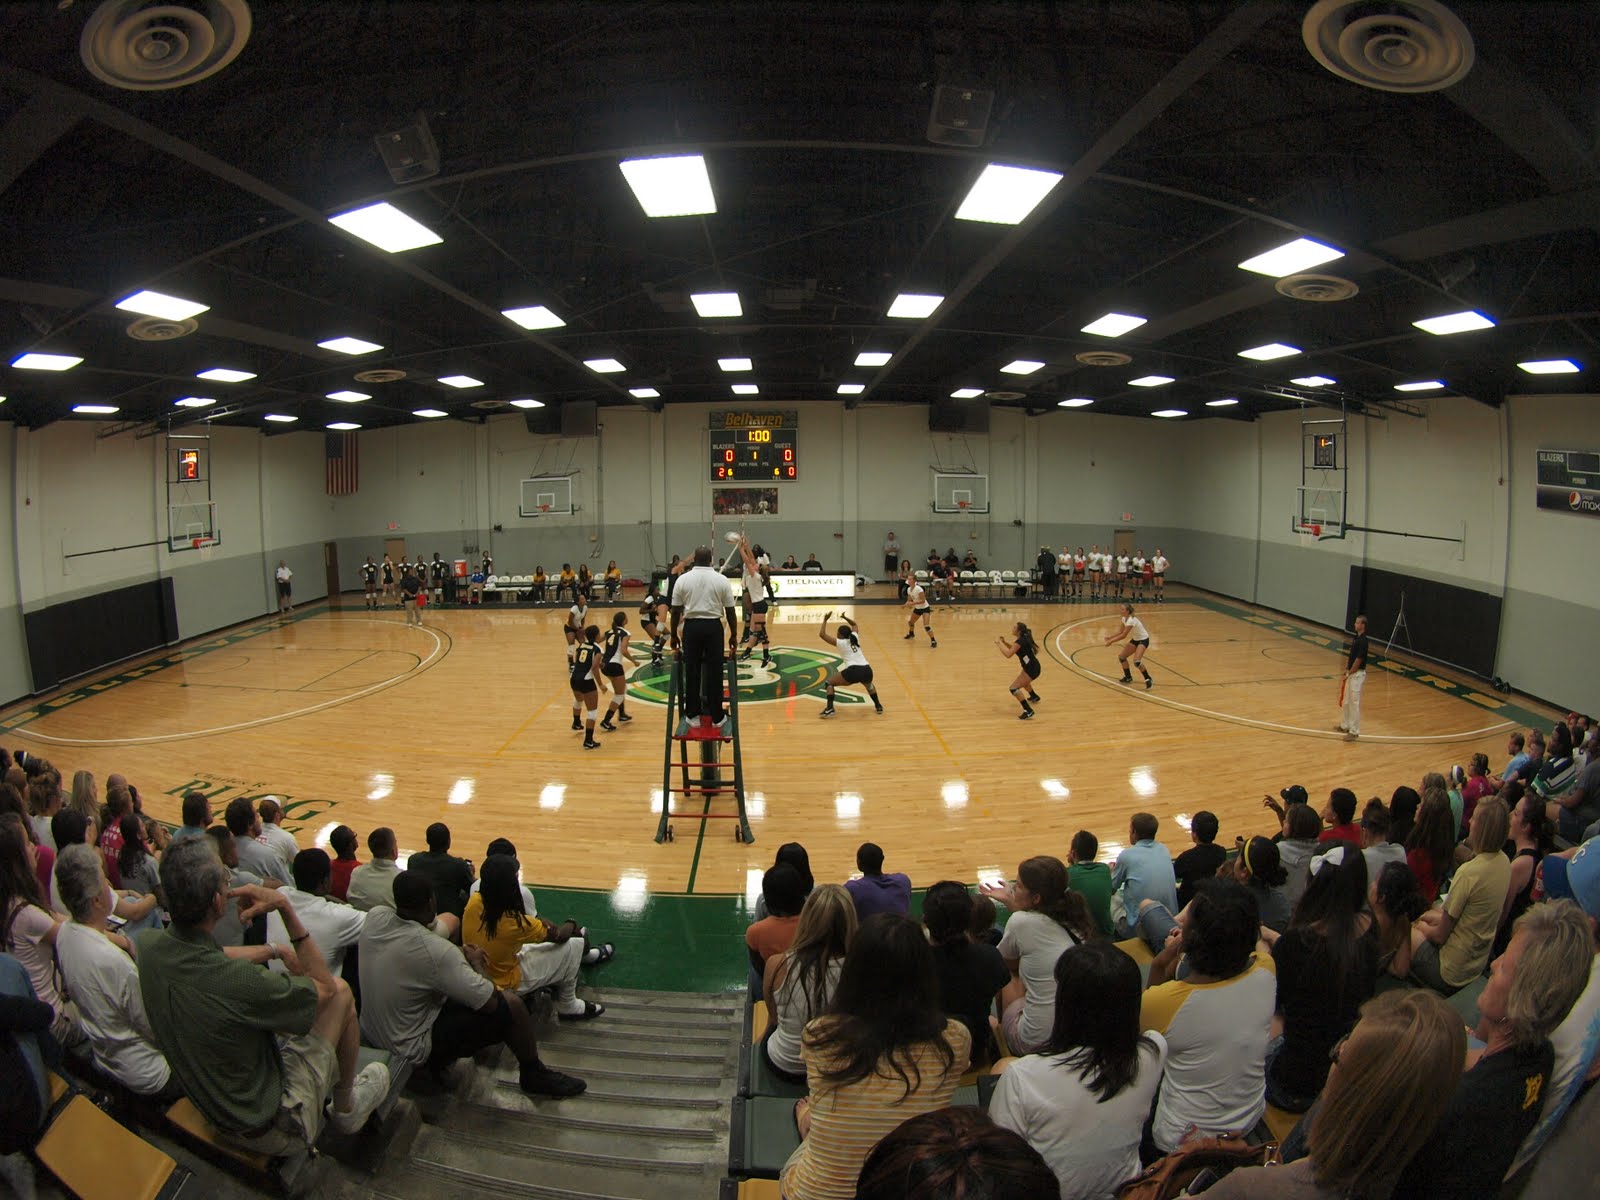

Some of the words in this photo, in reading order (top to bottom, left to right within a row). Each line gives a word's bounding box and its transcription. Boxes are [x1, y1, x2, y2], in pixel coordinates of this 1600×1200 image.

[725, 412, 783, 426] Belhaven
[748, 430, 770, 442] 1:00
[725, 449, 734, 462] 0
[784, 449, 792, 461] 0
[1539, 452, 1564, 463] BLAZERS
[578, 649, 588, 663] 8
